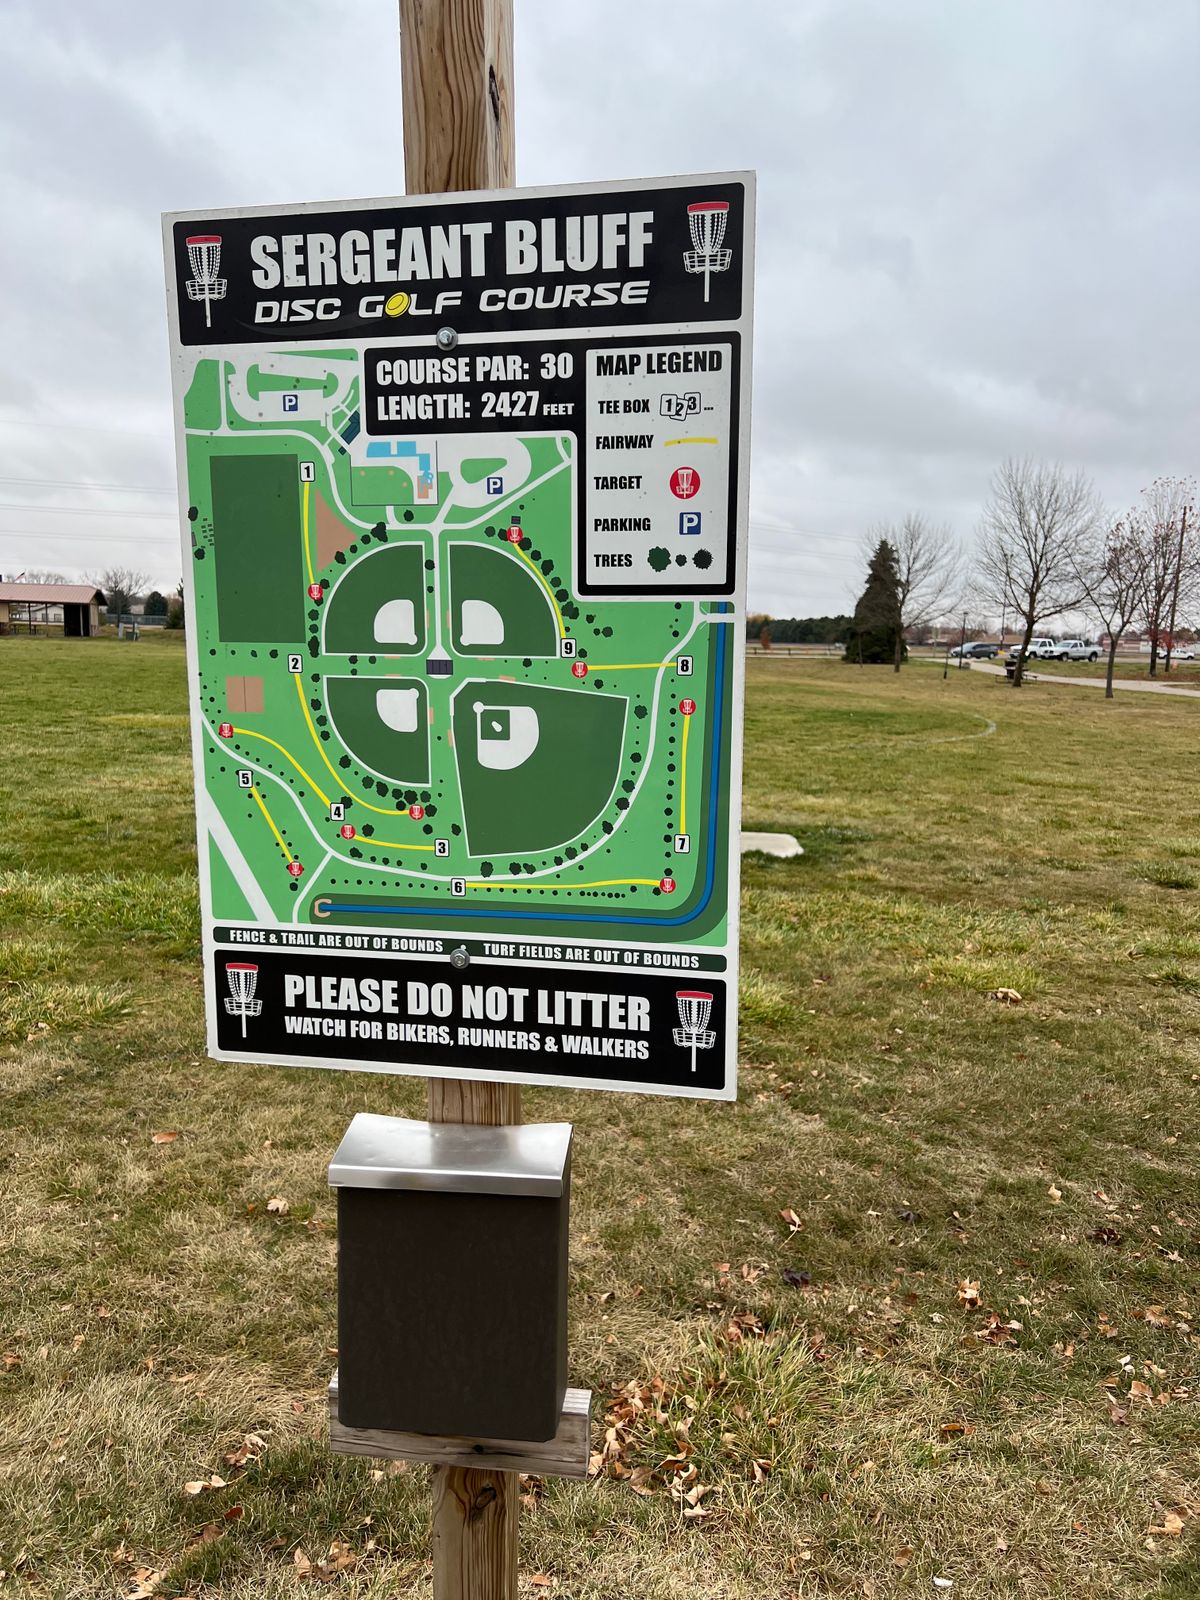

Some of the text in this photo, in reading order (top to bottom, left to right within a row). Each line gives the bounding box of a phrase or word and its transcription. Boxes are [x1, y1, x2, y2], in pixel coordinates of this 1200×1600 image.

[250, 211, 654, 289] SERGEANT BLUFF
[254, 299, 340, 323] DISC
[479, 280, 650, 312] COURSE
[376, 353, 574, 386] COURSE PAR: 30
[596, 350, 722, 376] MAP LEGEND
[286, 395, 296, 409] P
[377, 390, 575, 422] LENGTH: 2427 FEET
[598, 399, 650, 414] TEE BOX
[595, 435, 654, 450] FAIRWAY
[304, 466, 310, 478] 1
[490, 479, 501, 493] P
[594, 476, 642, 490] TARGET
[594, 518, 651, 532] PARKING
[683, 514, 698, 533] P
[594, 554, 632, 567] TREES
[564, 640, 573, 654] 9
[291, 658, 299, 670] 2
[681, 659, 689, 672] 8
[241, 772, 250, 784] 5
[333, 806, 341, 818] 4
[438, 842, 446, 854] 3
[678, 837, 686, 850] 7
[454, 881, 462, 893] 6
[229, 929, 444, 952] FENCE & TRAIL ARE OUT OF BOUNDS
[483, 942, 700, 968] TURF FIELDS ARE OUT OF BOUNDS
[284, 974, 650, 1031] PLEASE DO NOT LITTER
[284, 1016, 650, 1060] WATCH FOR BIKERS, RUNNERS & WALKERS
